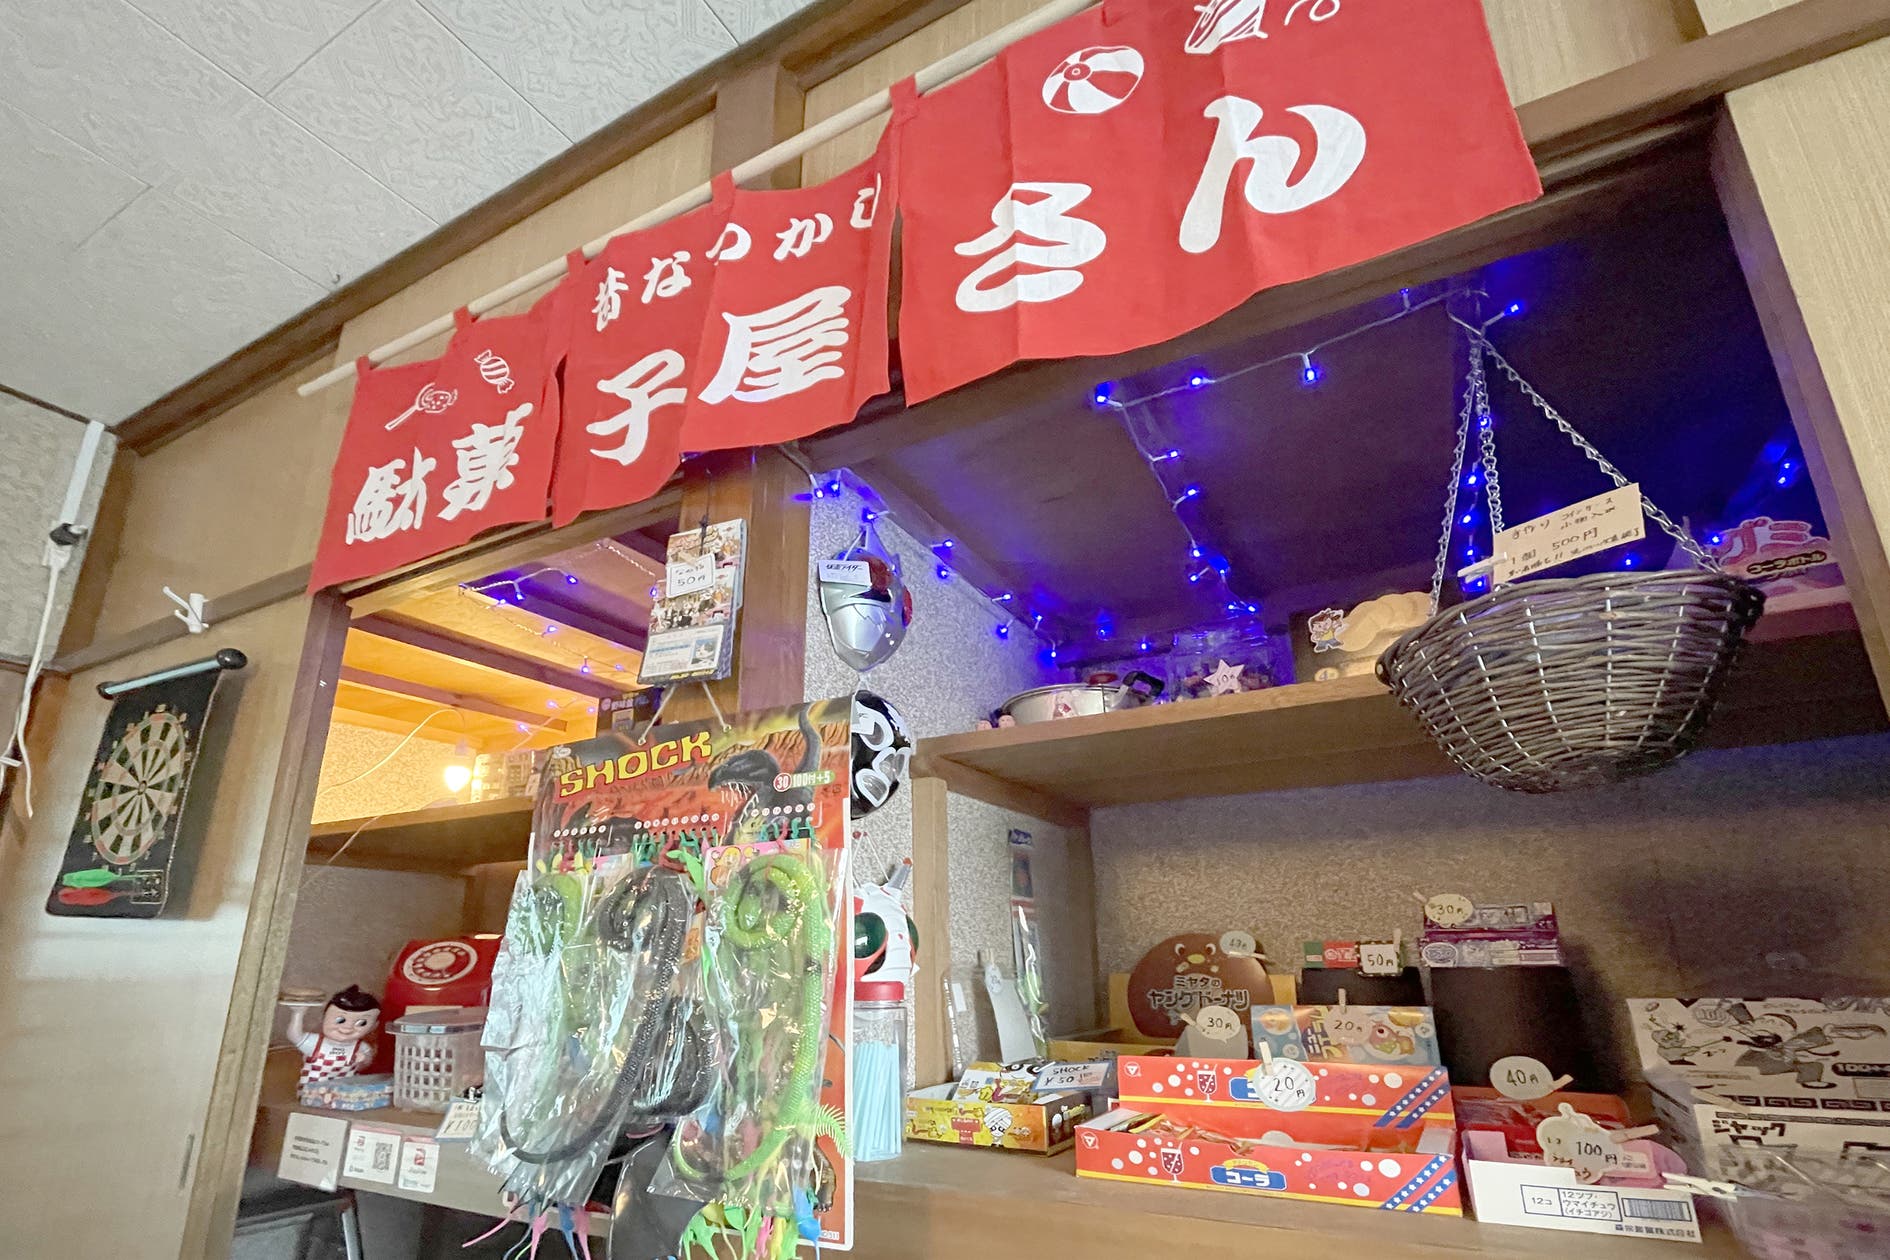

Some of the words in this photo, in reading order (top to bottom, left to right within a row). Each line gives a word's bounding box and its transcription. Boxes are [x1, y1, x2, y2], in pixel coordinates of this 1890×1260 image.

[1552, 527, 1599, 551] 500円
[1748, 551, 1826, 574] コーラボトル
[560, 731, 713, 797] SHOCK
[1367, 954, 1394, 967] 50円
[1175, 975, 1222, 988] ミヤタの
[1148, 989, 1250, 1011] ヤングドーナツ
[1206, 1017, 1233, 1030] 30円
[1273, 1077, 1306, 1098] 20円
[1506, 1069, 1539, 1087] 40円
[1712, 1119, 1787, 1137] ジャック
[1576, 1141, 1618, 1166] 100円
[1226, 1171, 1271, 1188] コーラ
